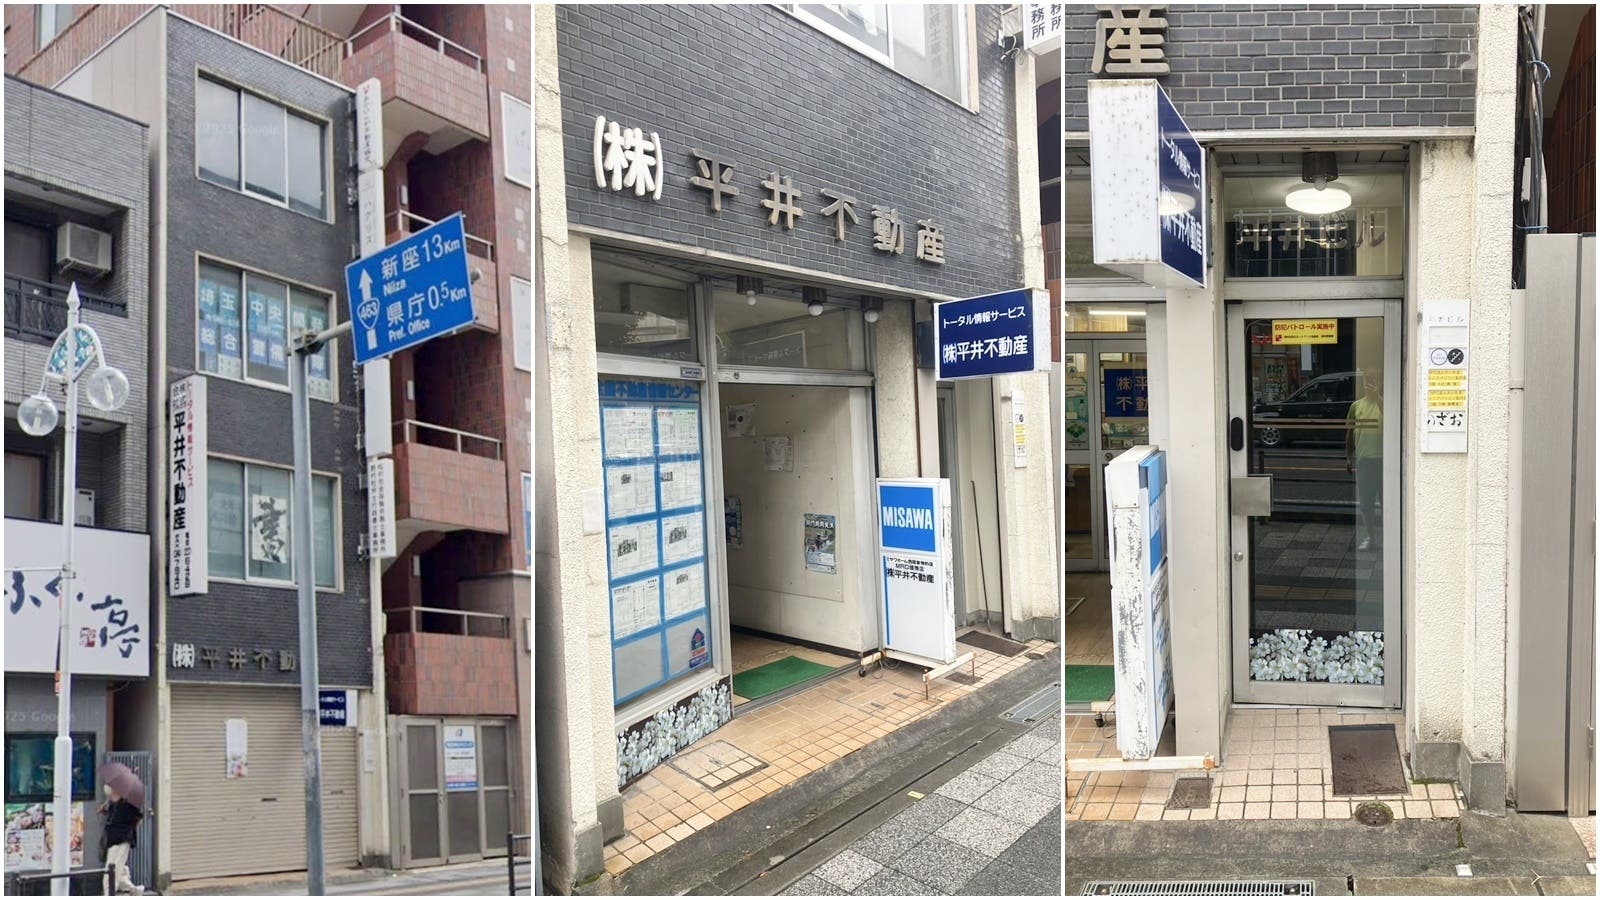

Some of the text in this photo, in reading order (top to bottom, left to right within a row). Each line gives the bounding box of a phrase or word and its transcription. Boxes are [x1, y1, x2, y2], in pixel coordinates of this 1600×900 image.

[1030, 4, 1046, 40] 務所
[1091, 4, 1169, 75] 産
[594, 115, 947, 265] (株)平井不動産
[381, 245, 421, 281] 新座
[383, 279, 408, 297] Niiza
[360, 301, 379, 321] 463
[386, 291, 426, 328] 県庁
[942, 305, 1027, 329] トータル情報サービス
[389, 318, 431, 343] Pref. Office
[1274, 323, 1336, 332] 防犯パトロール実施中
[943, 334, 1029, 365] (株)平井不動産
[882, 506, 934, 531] MISAWA
